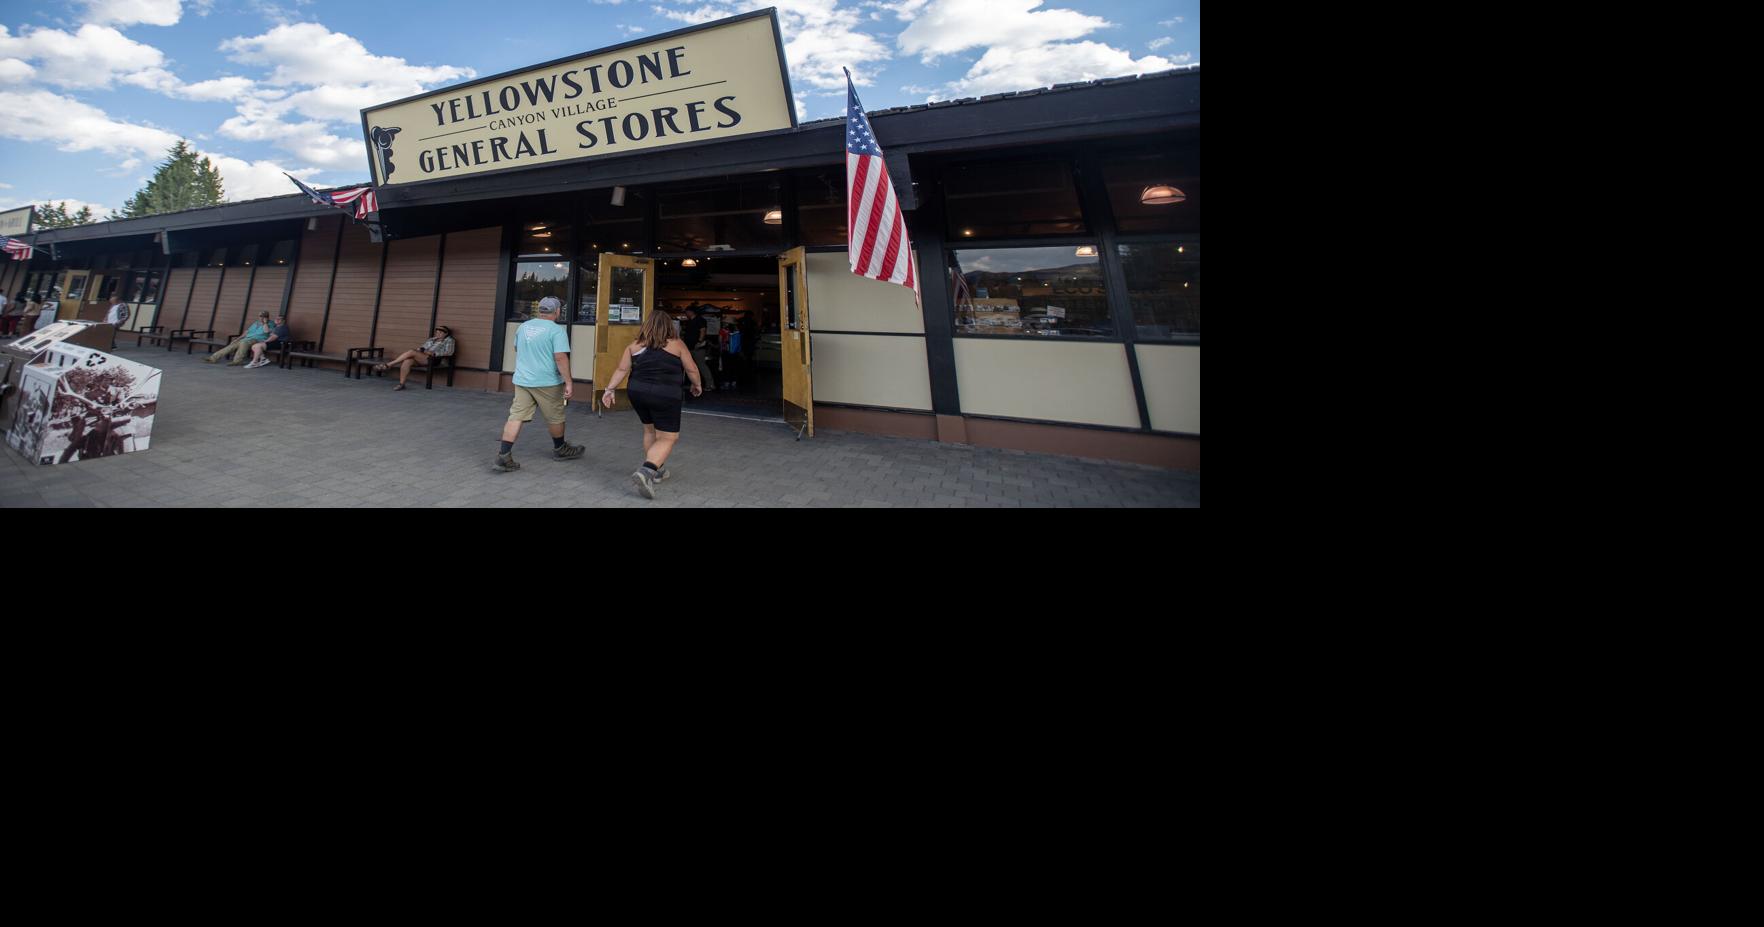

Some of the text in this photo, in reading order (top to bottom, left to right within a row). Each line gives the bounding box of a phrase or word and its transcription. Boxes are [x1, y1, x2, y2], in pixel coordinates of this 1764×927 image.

[431, 45, 692, 126] YELLOWSTONE
[489, 98, 618, 131] CANYON VILLAGE
[419, 96, 742, 173] GENERAL STORES
